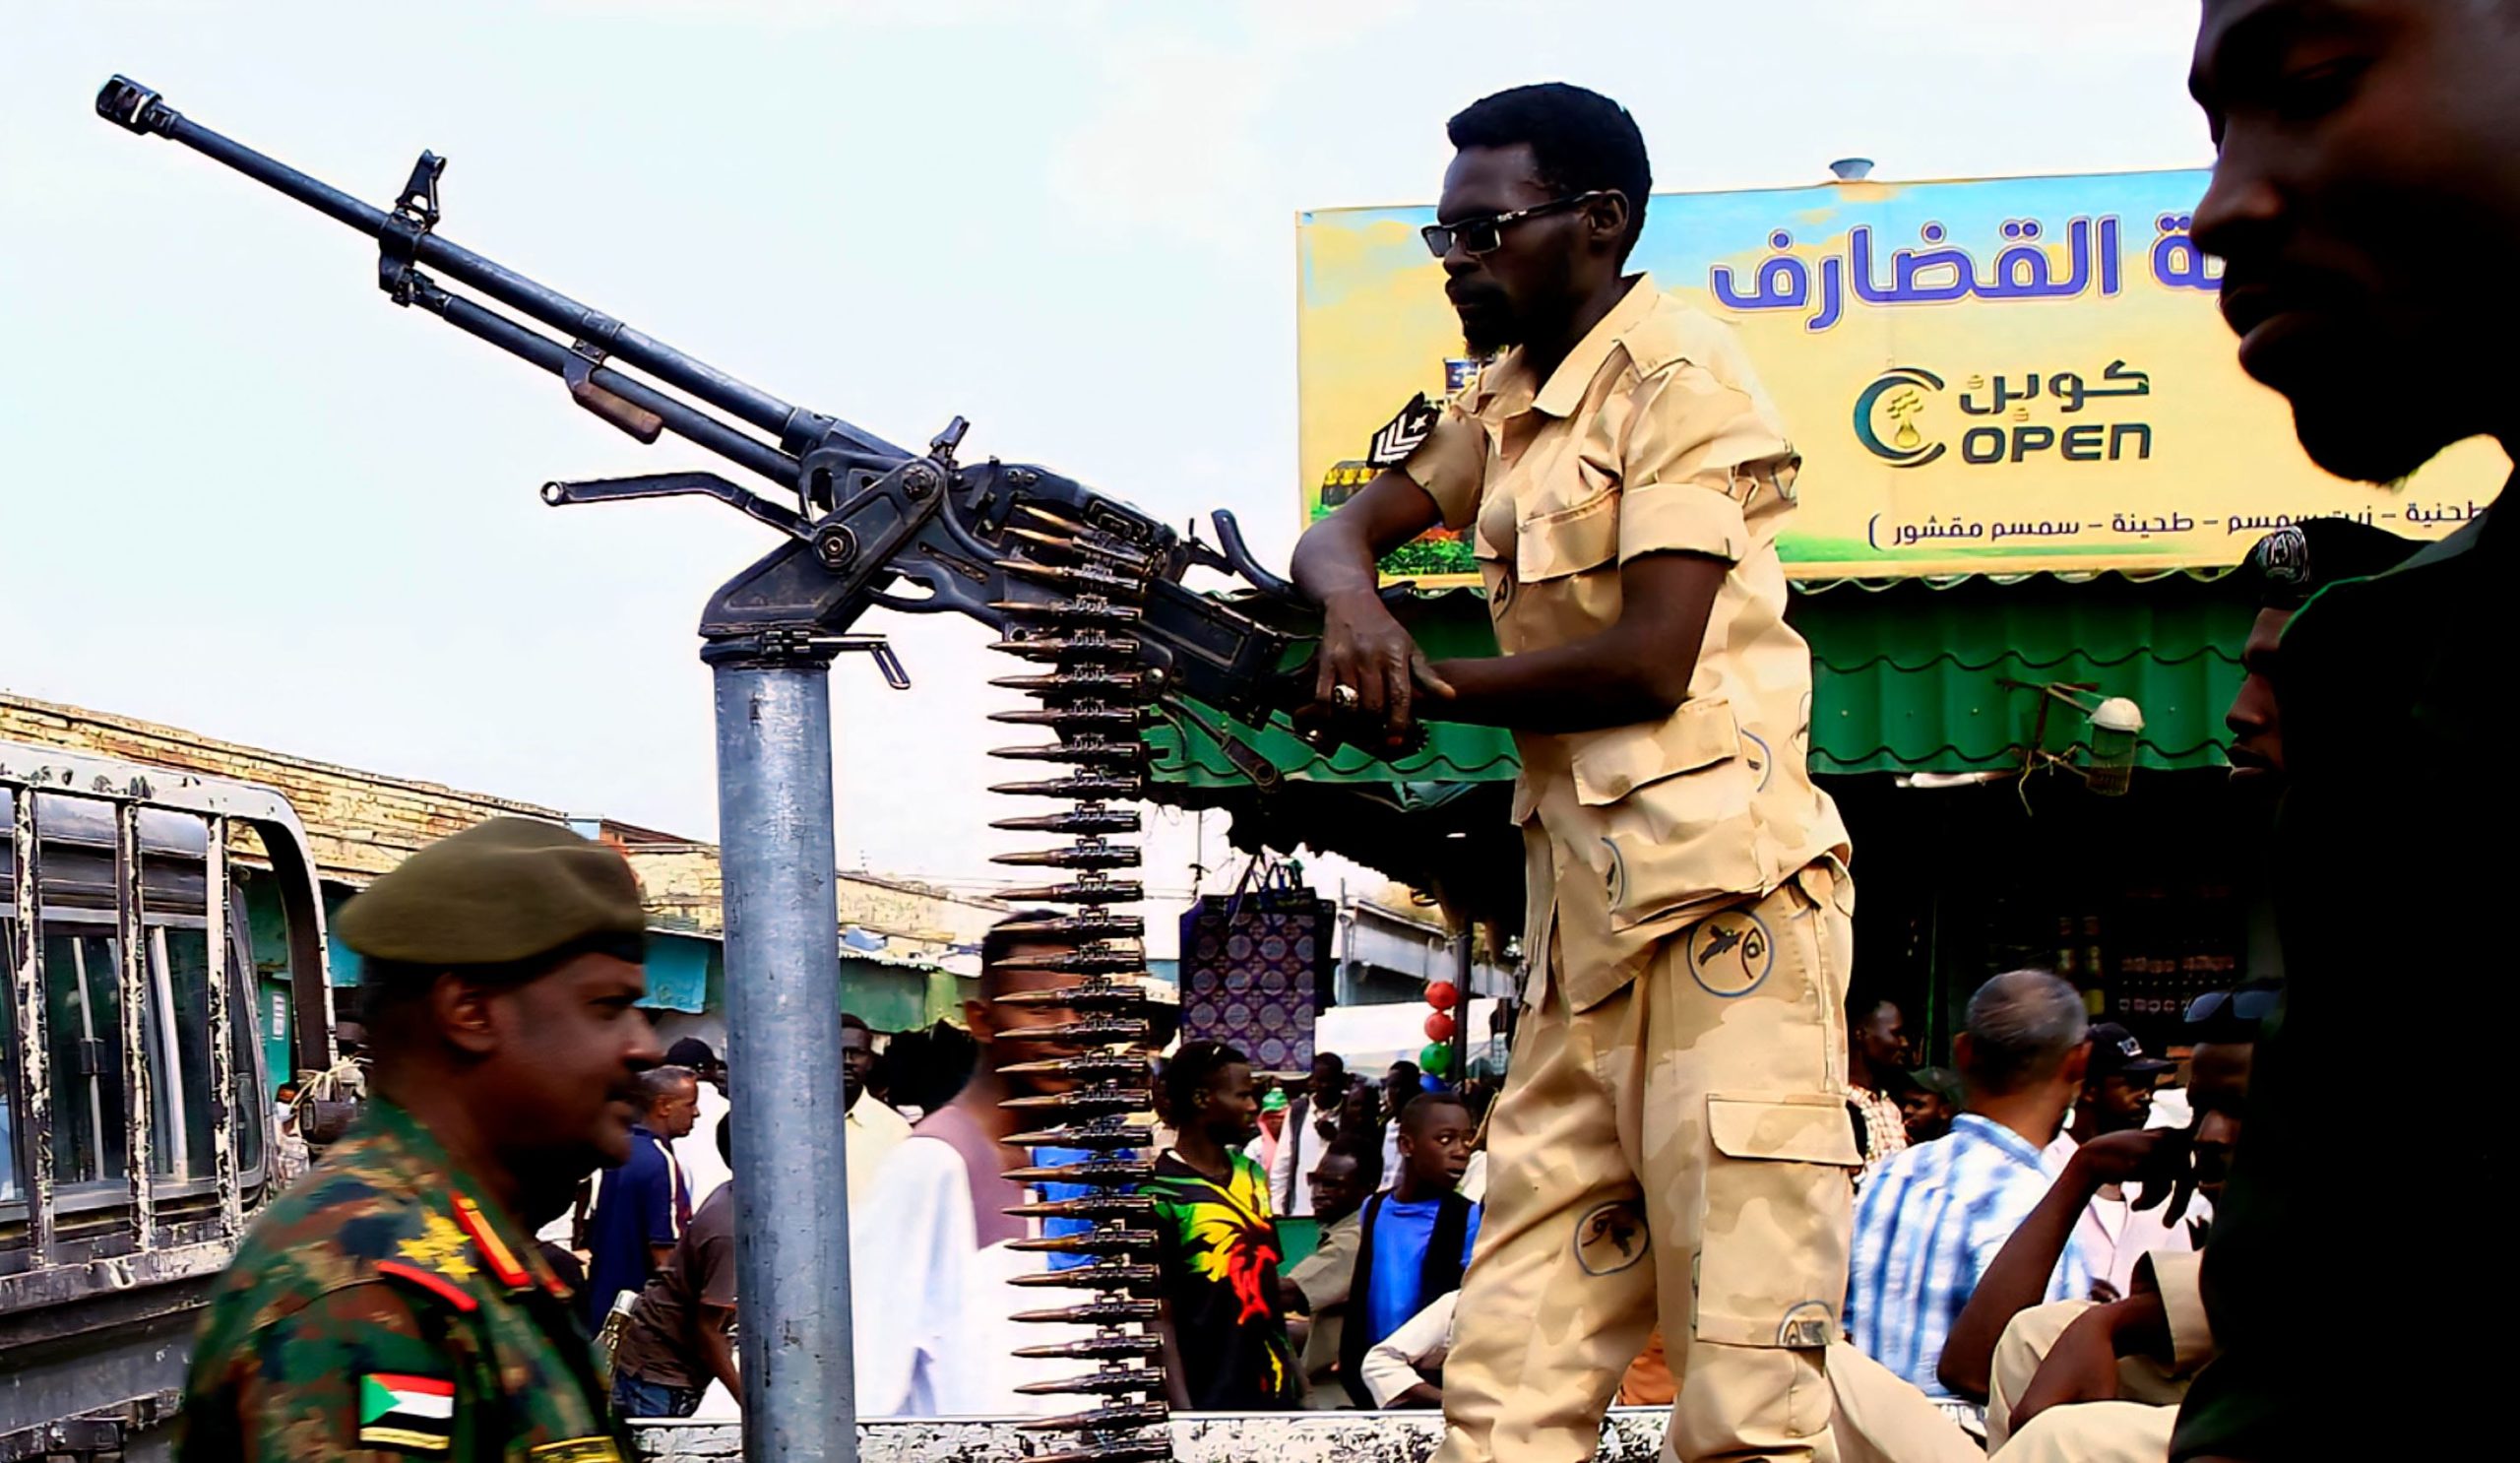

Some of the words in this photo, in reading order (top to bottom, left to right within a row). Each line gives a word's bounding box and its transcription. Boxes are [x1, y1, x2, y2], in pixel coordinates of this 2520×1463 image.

[1710, 214, 2120, 333] القضارف
[1962, 423, 2152, 465] OPEN
[1892, 515, 1984, 546] مقشور
[1990, 521, 2079, 542] سمسم
[2111, 511, 2195, 539] طحينة
